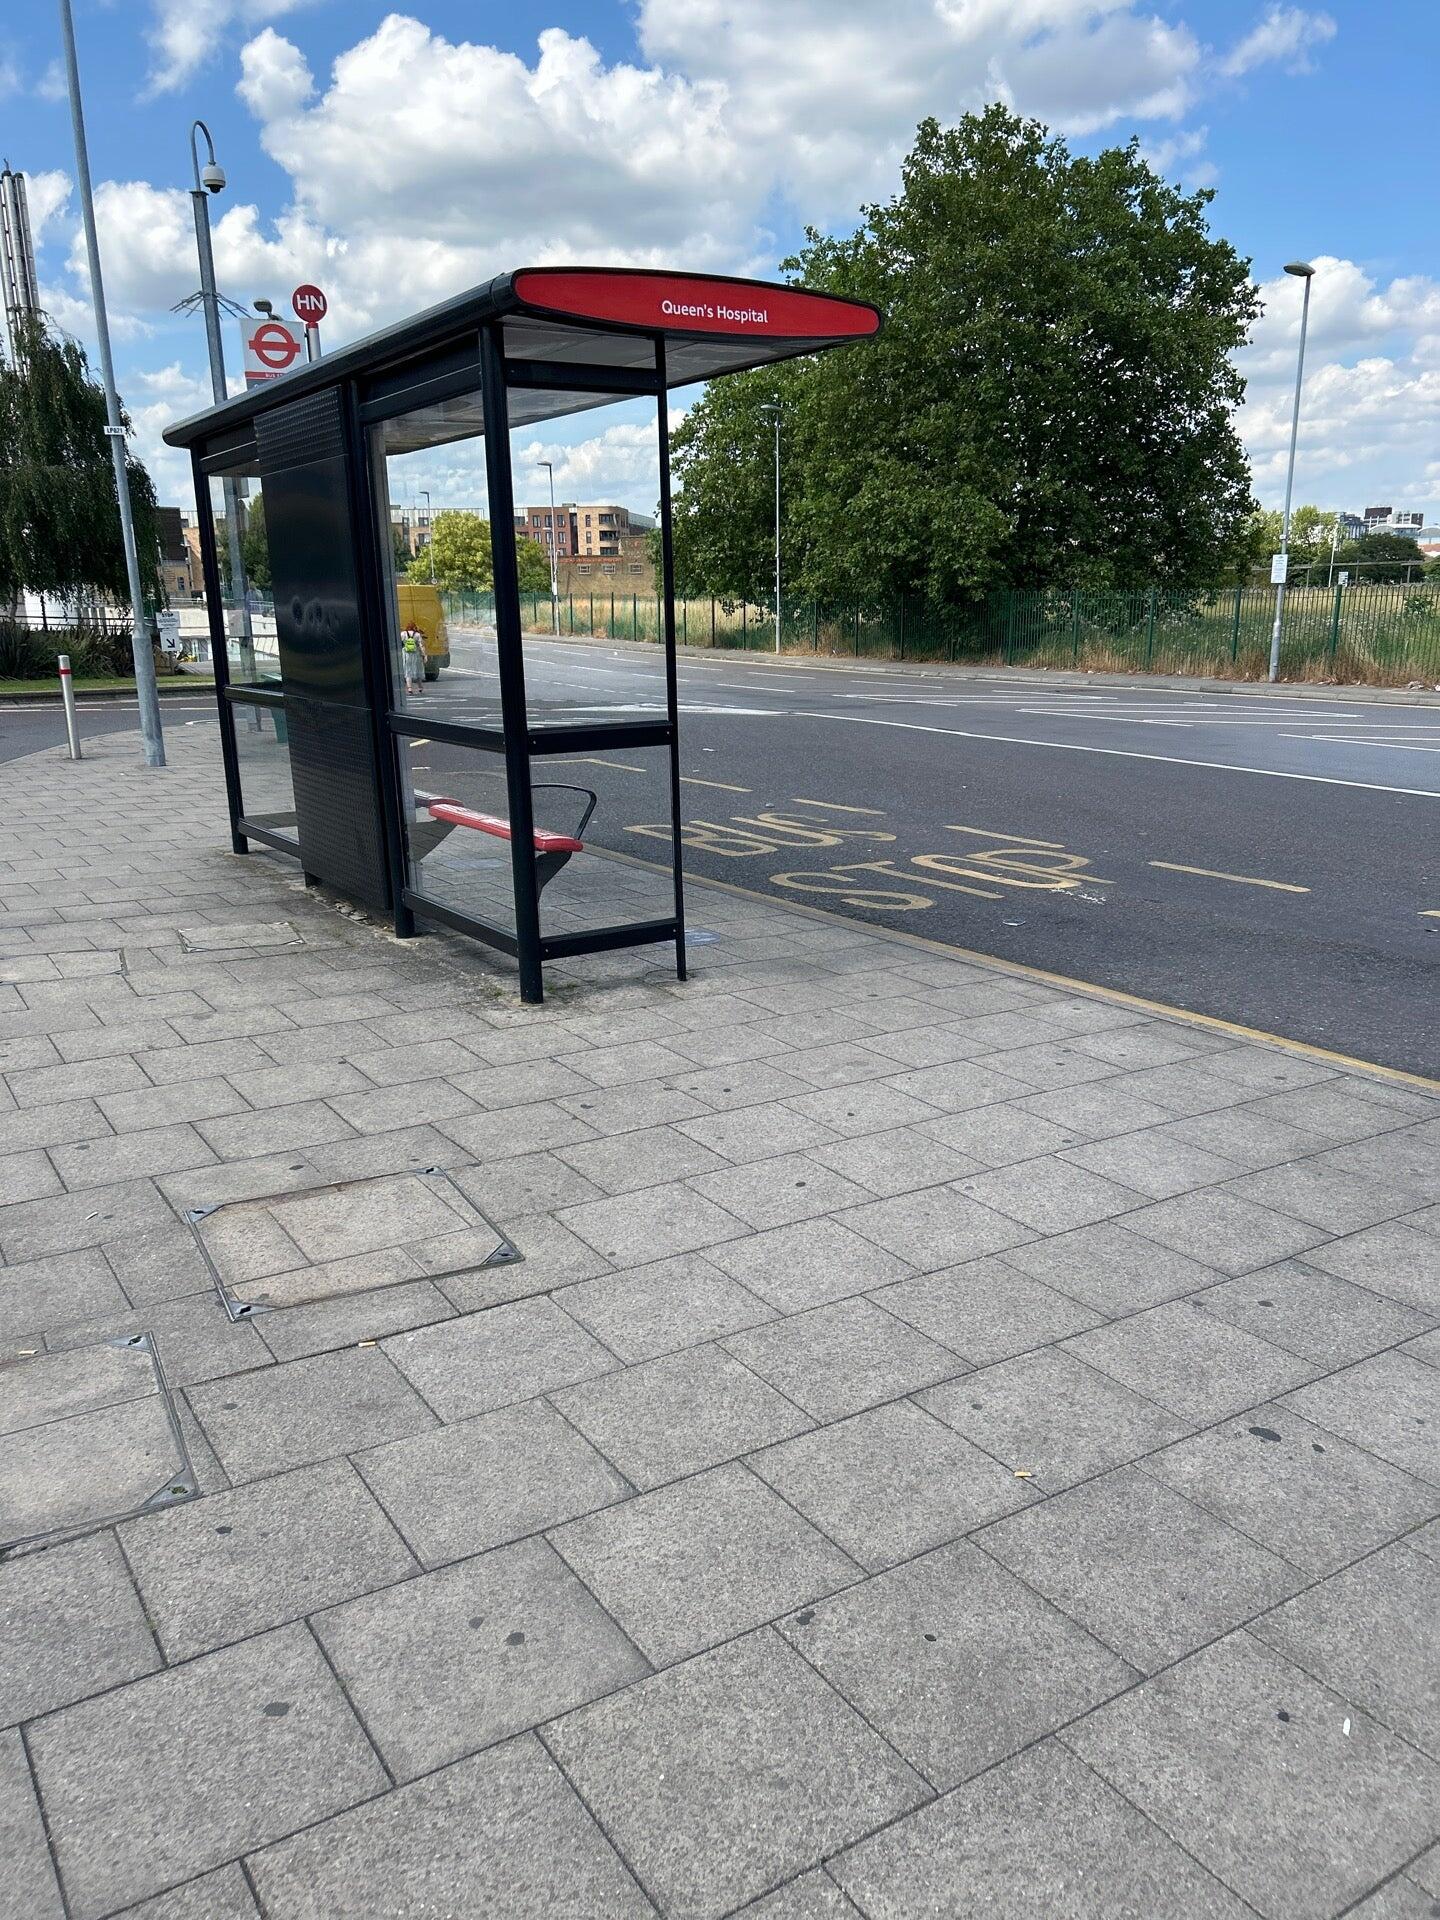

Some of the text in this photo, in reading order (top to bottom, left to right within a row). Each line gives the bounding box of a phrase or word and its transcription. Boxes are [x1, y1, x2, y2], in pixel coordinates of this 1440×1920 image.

[296, 294, 325, 311] HN
[661, 300, 768, 324] Queen's Hospital
[622, 812, 897, 857] BUS
[768, 848, 1117, 911] STOP
